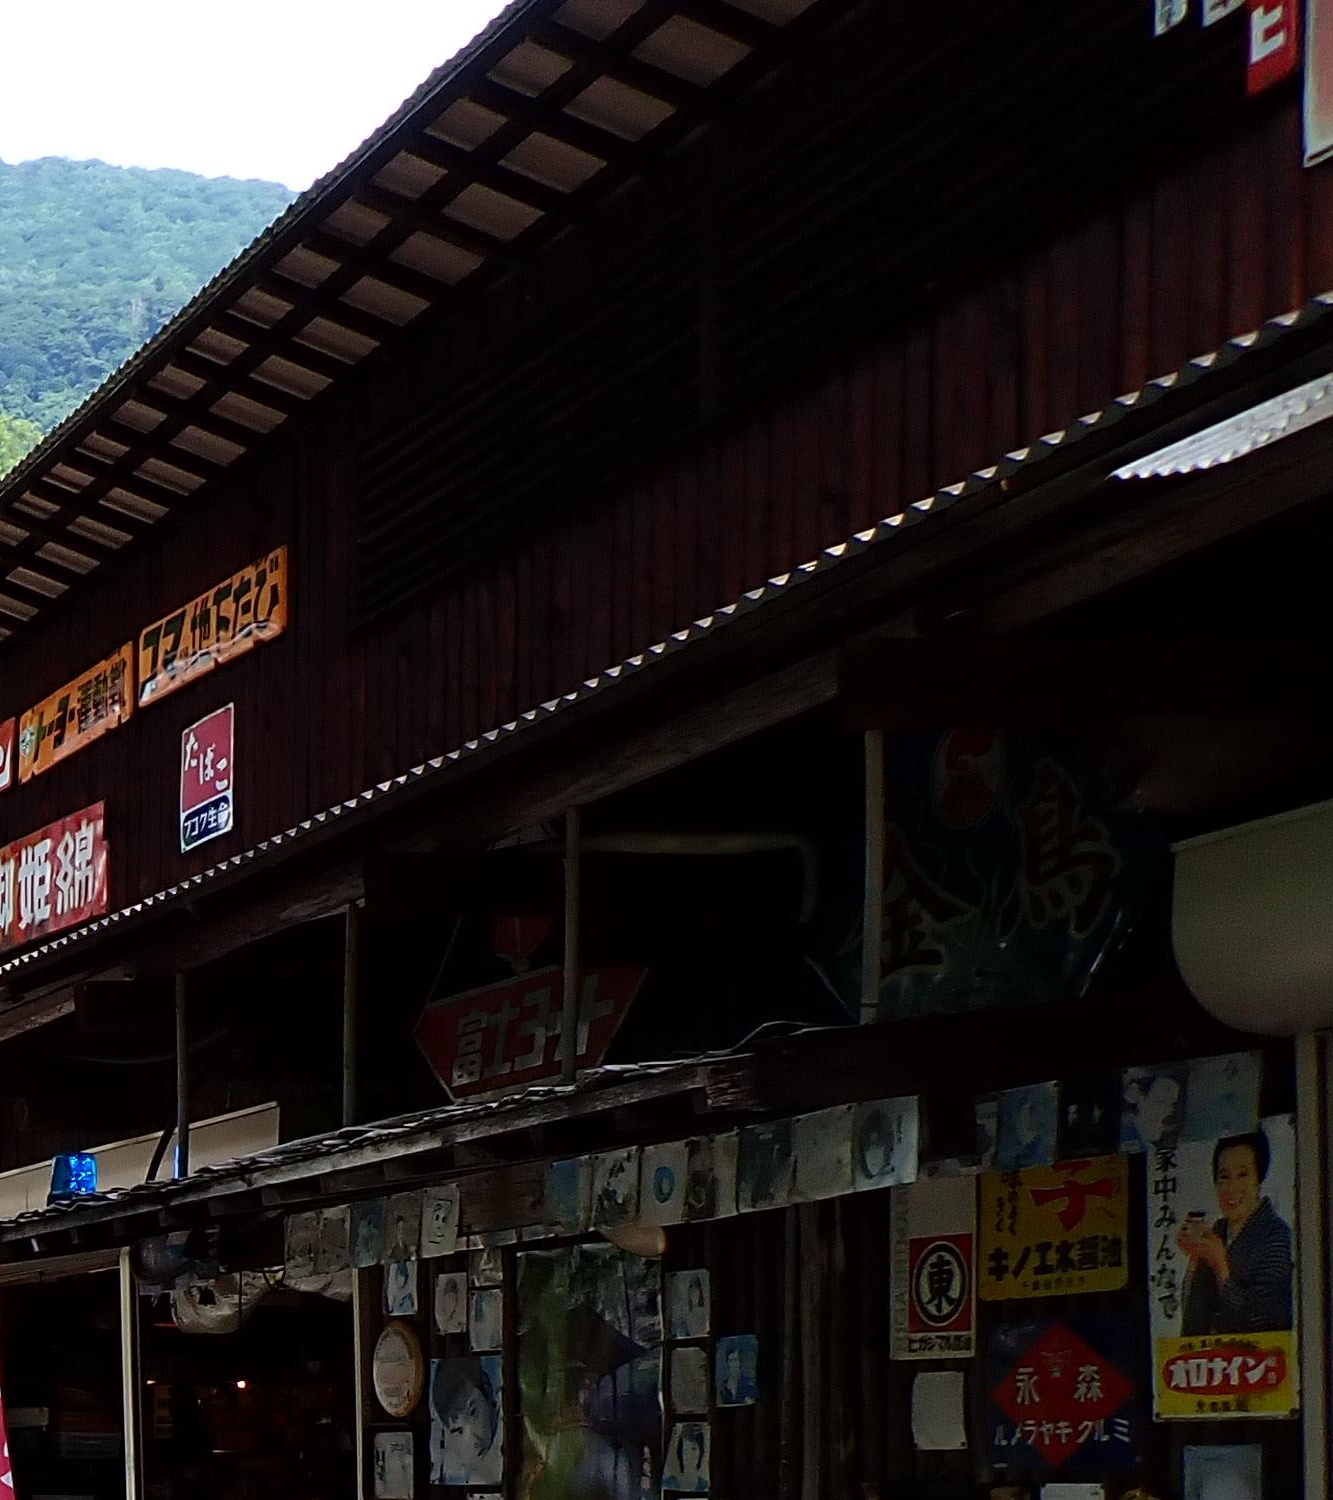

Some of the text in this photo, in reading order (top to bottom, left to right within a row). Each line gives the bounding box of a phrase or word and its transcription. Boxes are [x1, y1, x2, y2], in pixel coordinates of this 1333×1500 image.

[184, 732, 230, 791] たばこ
[183, 801, 230, 838] フコク生命
[1151, 1145, 1179, 1320] 家中みんなで
[925, 1255, 956, 1315] 東
